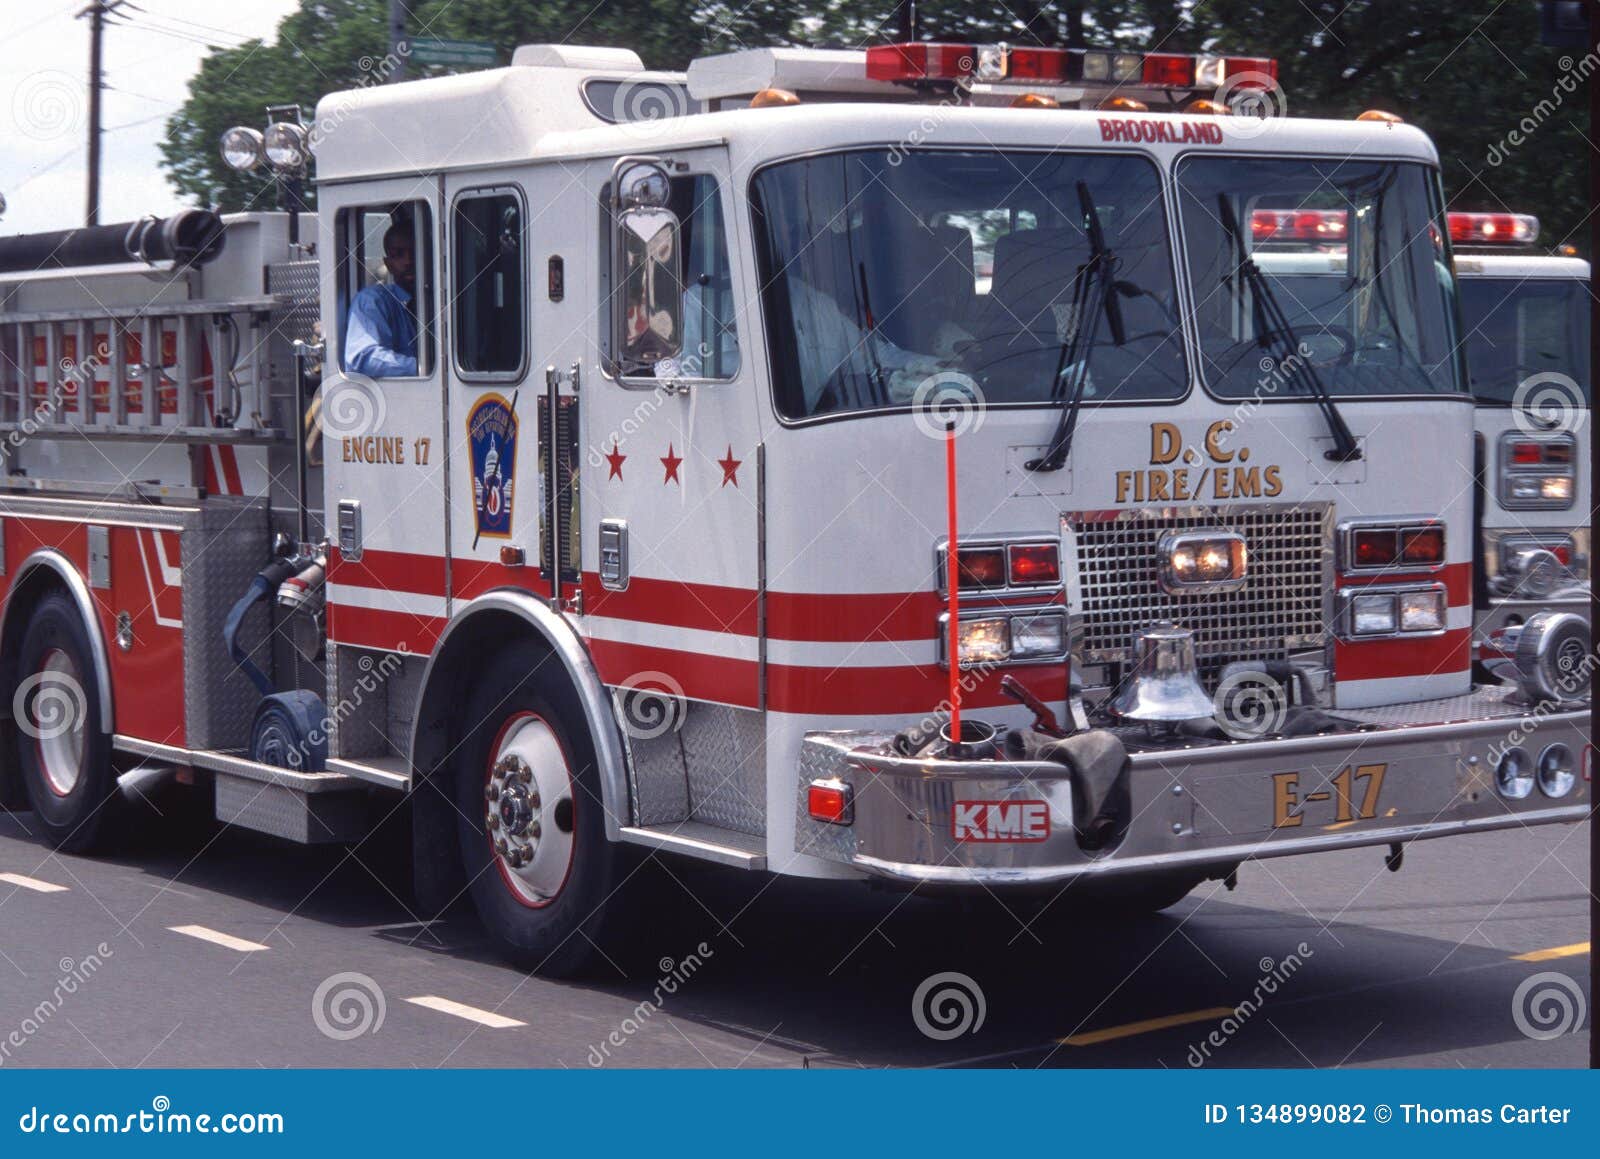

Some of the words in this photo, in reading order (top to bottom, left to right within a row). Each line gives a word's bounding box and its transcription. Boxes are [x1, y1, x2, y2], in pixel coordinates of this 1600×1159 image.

[1097, 118, 1223, 145] BROOKLAND
[342, 435, 405, 464] ENGINE
[414, 437, 431, 465] 17
[1115, 464, 1284, 503] FIRE/EMS
[1272, 762, 1388, 829] E-17
[954, 803, 1048, 840] KME
